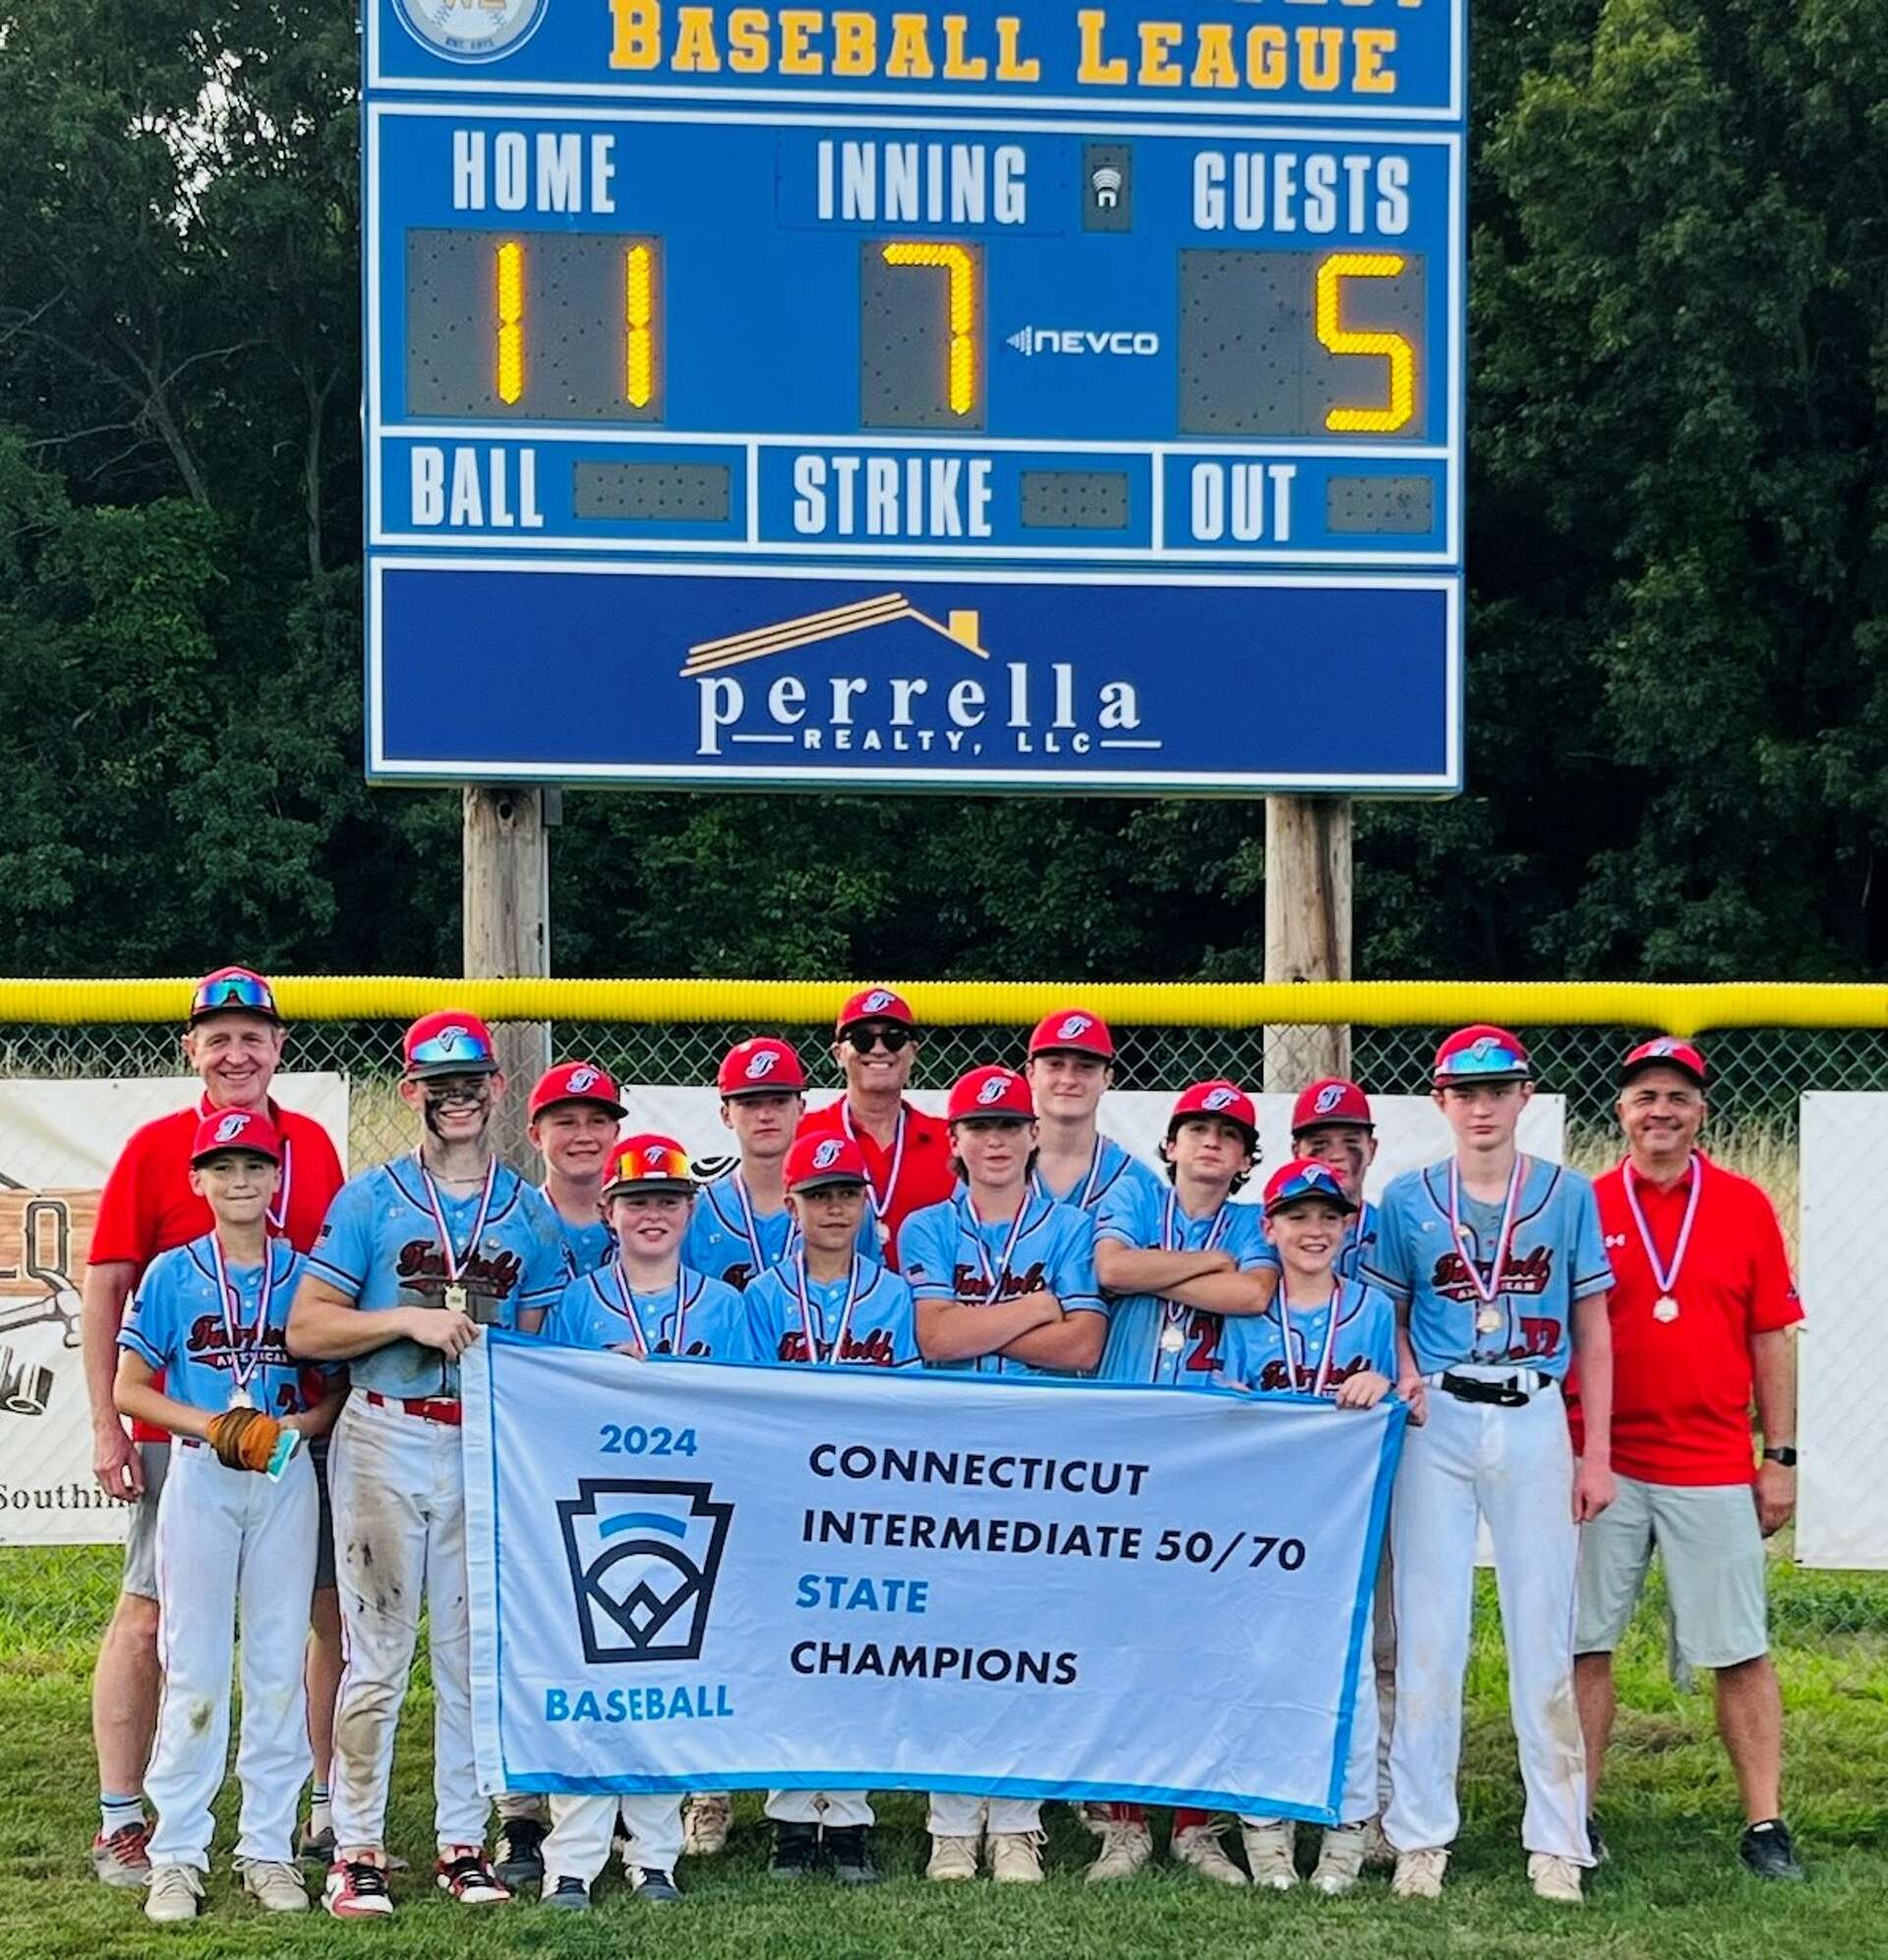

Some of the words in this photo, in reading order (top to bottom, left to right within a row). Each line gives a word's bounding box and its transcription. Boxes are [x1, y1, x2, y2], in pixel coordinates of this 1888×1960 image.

[608, 0, 1040, 83] BASEBALL
[1077, 10, 1397, 93] LEAGUE
[452, 130, 617, 213] HOME
[817, 141, 1027, 225] INNING
[1193, 151, 1410, 235] GUESTS
[881, 243, 974, 415] 7
[1316, 253, 1415, 433] 5
[410, 445, 545, 528] BALL
[793, 454, 994, 538] STRIKE
[1191, 461, 1297, 543] OUT
[695, 661, 1142, 755] perrella
[803, 728, 983, 755] REALTY,
[1017, 730, 1092, 753] LLC
[600, 1424, 697, 1456] 2024
[809, 1443, 1150, 1496] CONNECTICUT
[802, 1509, 1143, 1560] INTERMEDIATE
[1155, 1530, 1307, 1574] 50/70
[796, 1574, 929, 1614] STATE
[546, 1685, 734, 1723] BASEBALL
[791, 1640, 1078, 1686] CHAMPIONS
